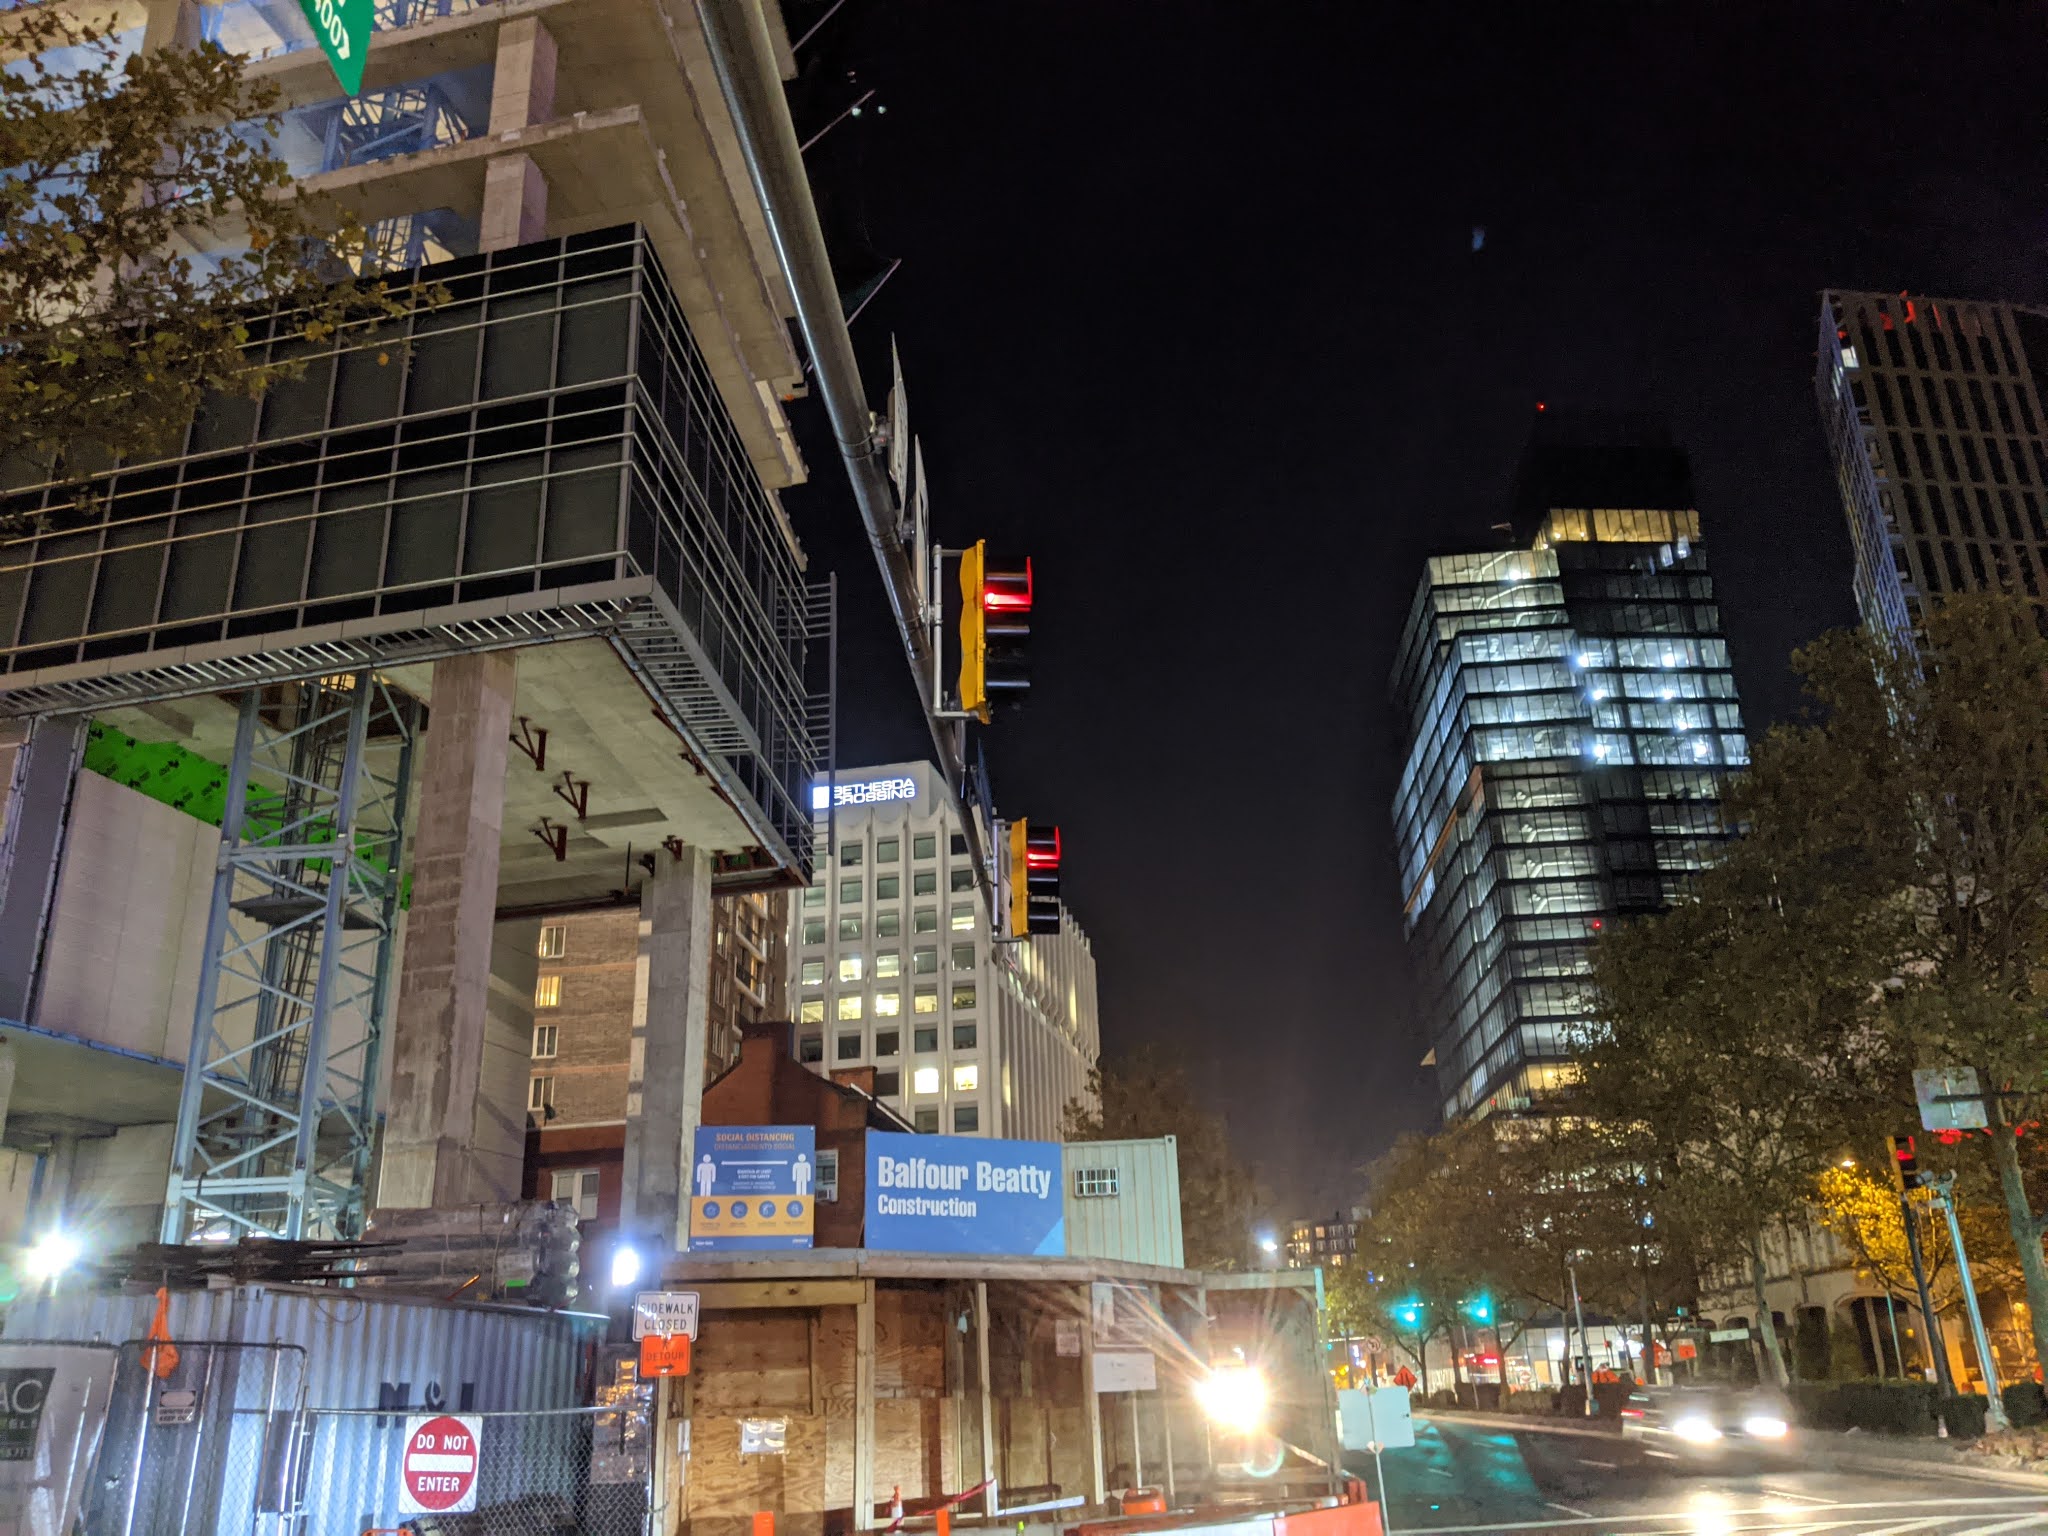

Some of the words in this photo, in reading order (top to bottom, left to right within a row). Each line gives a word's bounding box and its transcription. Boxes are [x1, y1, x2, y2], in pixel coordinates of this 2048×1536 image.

[833, 778, 914, 796] BETHESDA
[716, 1133, 743, 1142] SOCIAL
[746, 1132, 794, 1141] DISTANCING
[878, 1156, 968, 1190] Balfour
[976, 1161, 1051, 1199] Beatty
[878, 1194, 977, 1217] Construction
[641, 1303, 693, 1314] SIDEWALK
[644, 1319, 687, 1330] CLOSED
[647, 1352, 685, 1361] DETOUR
[416, 1434, 435, 1449] DO
[443, 1435, 469, 1450] NOT
[417, 1476, 460, 1492] ENTER
